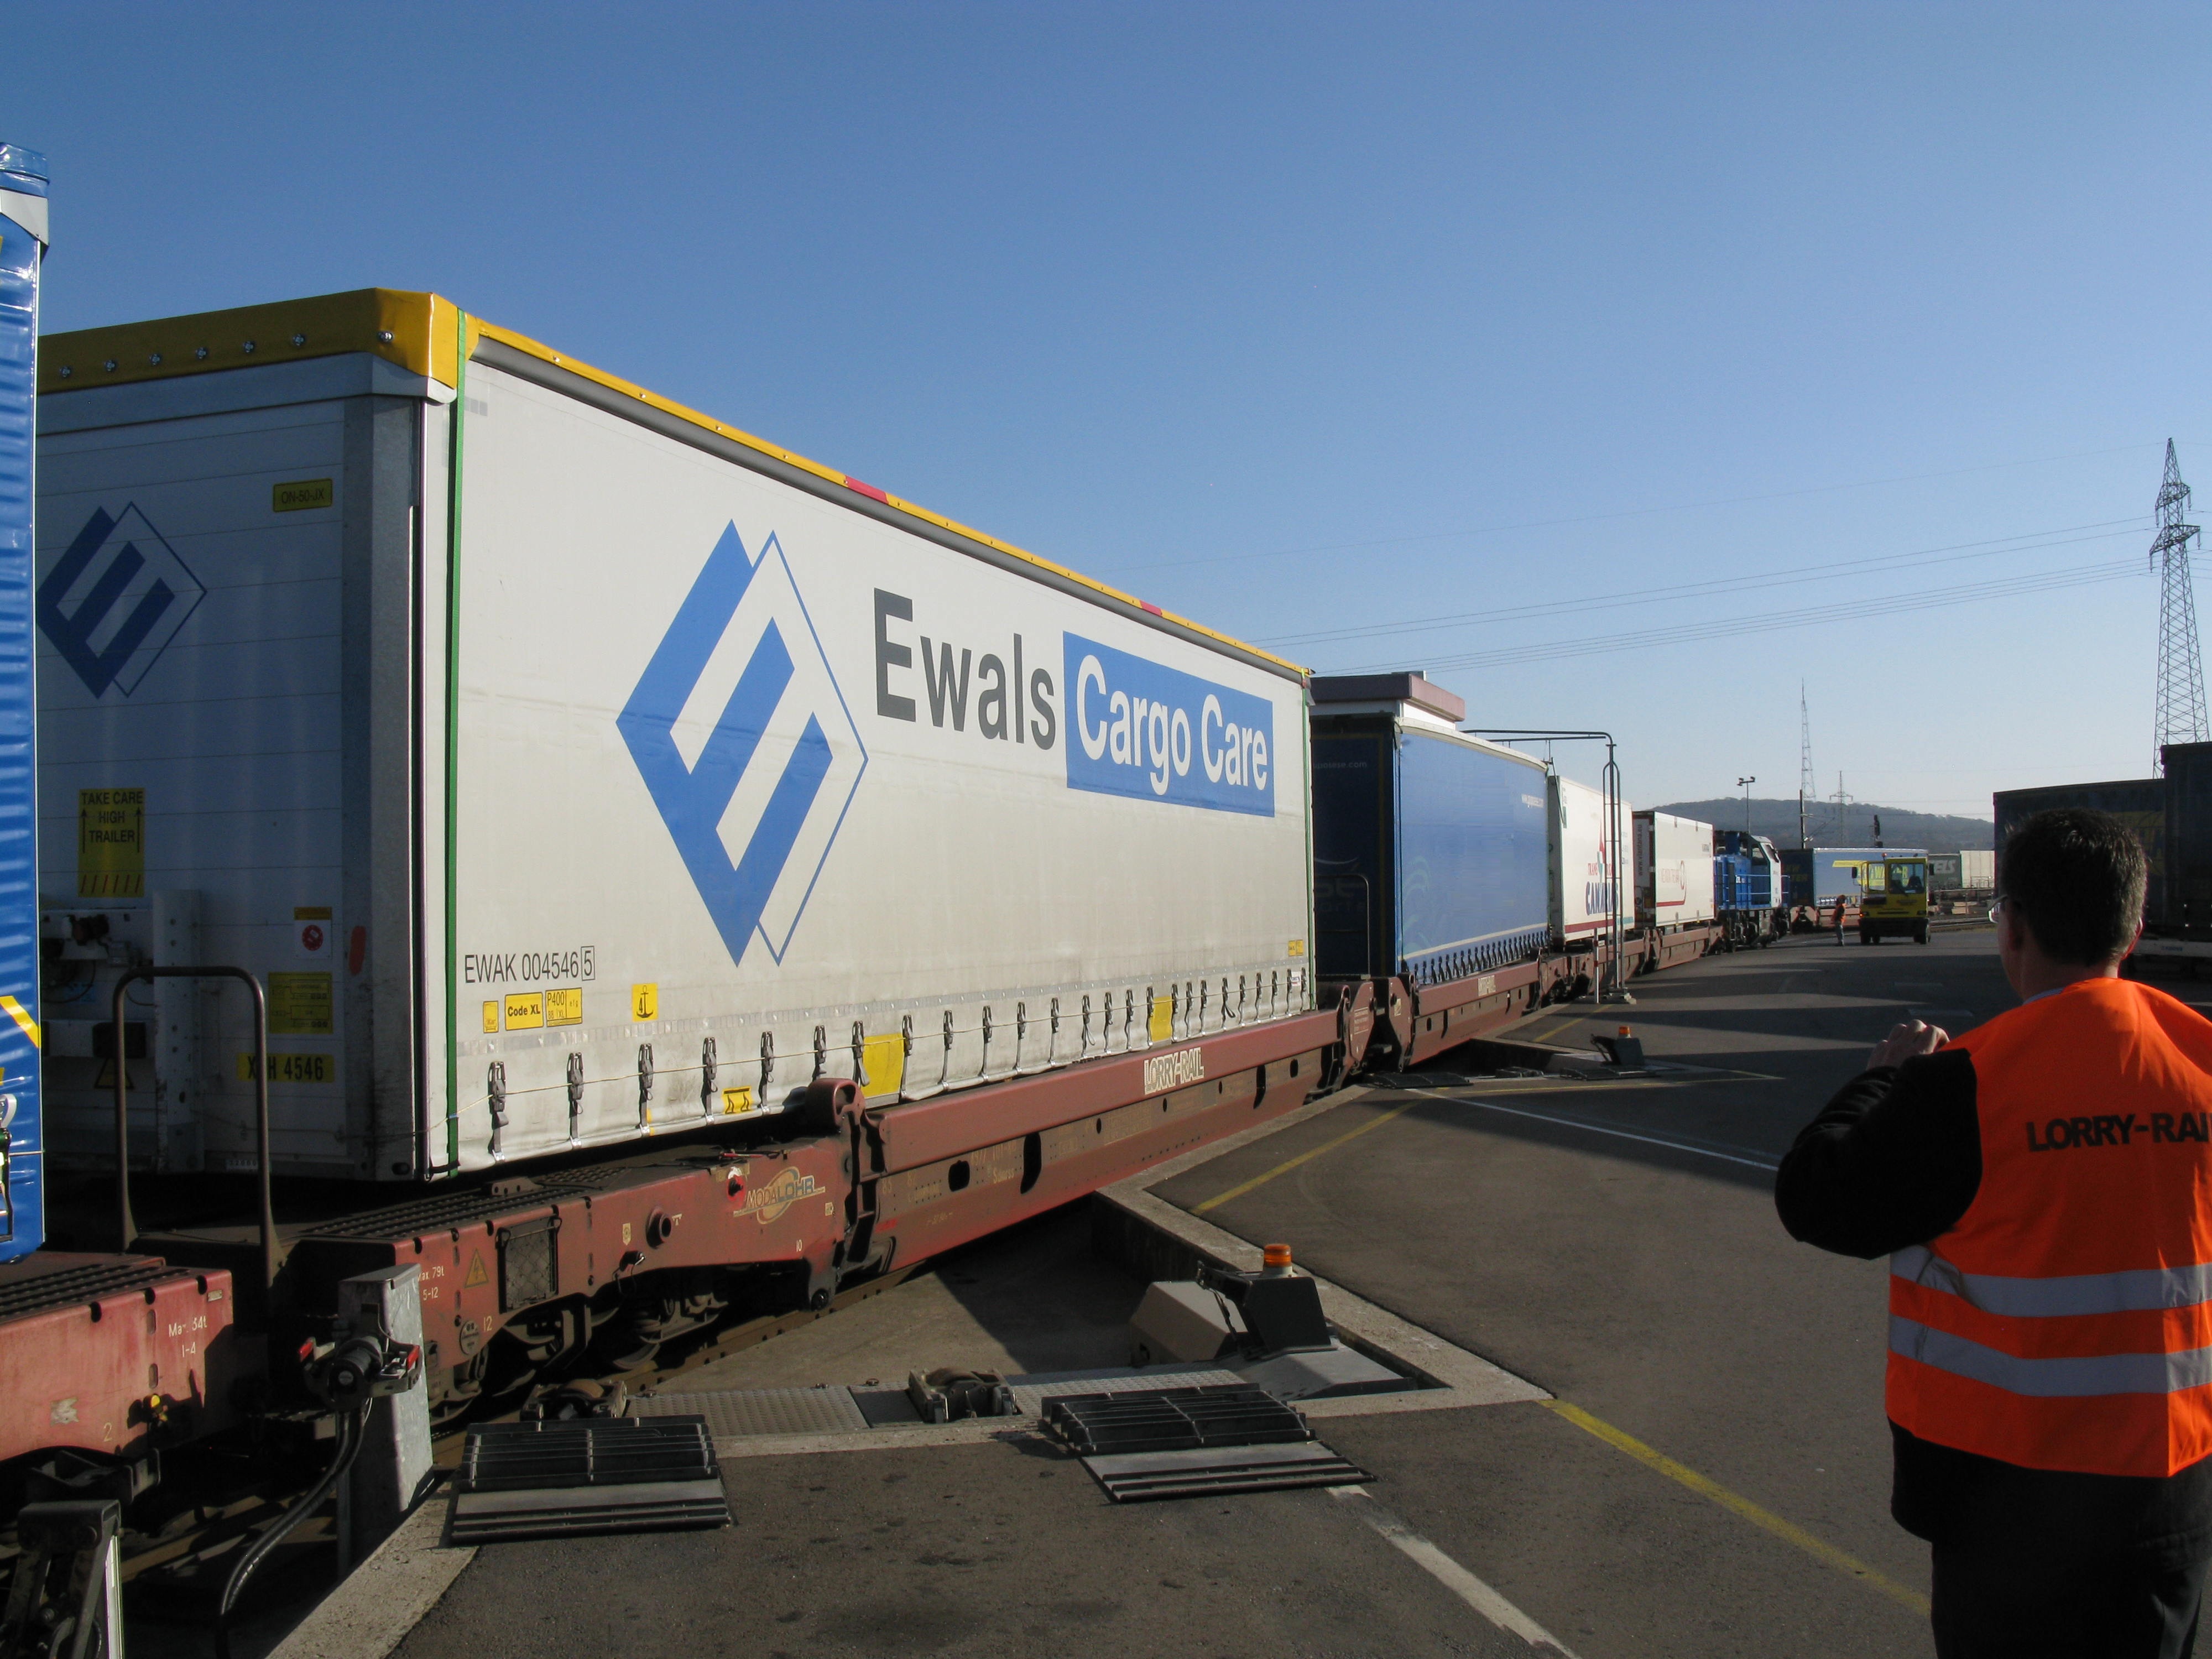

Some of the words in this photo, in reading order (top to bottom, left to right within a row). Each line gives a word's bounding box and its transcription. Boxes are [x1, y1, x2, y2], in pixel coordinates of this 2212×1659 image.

[281, 488, 325, 504] ON-50-JX
[873, 587, 1056, 750] Ewals
[1077, 655, 1191, 795] Cargo
[1201, 694, 1268, 790] Care
[81, 791, 110, 805] TAKE
[113, 790, 144, 805] CARE
[98, 810, 126, 823] HIGH
[88, 830, 135, 843] TRAILER
[465, 953, 517, 984] EWAK
[521, 951, 579, 982] 004546
[583, 950, 593, 977] 5
[547, 992, 564, 1006] P400
[508, 1006, 528, 1017] Code
[530, 1004, 541, 1015] XL
[247, 1055, 276, 1080] XH
[284, 1056, 324, 1081] 4546
[1143, 1047, 1205, 1095] LORRY-RAIL
[2026, 1112, 2212, 1152] LORRY-RAI
[747, 1175, 815, 1209] MODALOHR
[433, 1265, 445, 1279] 79t
[422, 1286, 439, 1301] 5-12
[483, 1314, 493, 1332] 12
[181, 1340, 197, 1358] 1-4
[103, 1422, 113, 1442] 2
